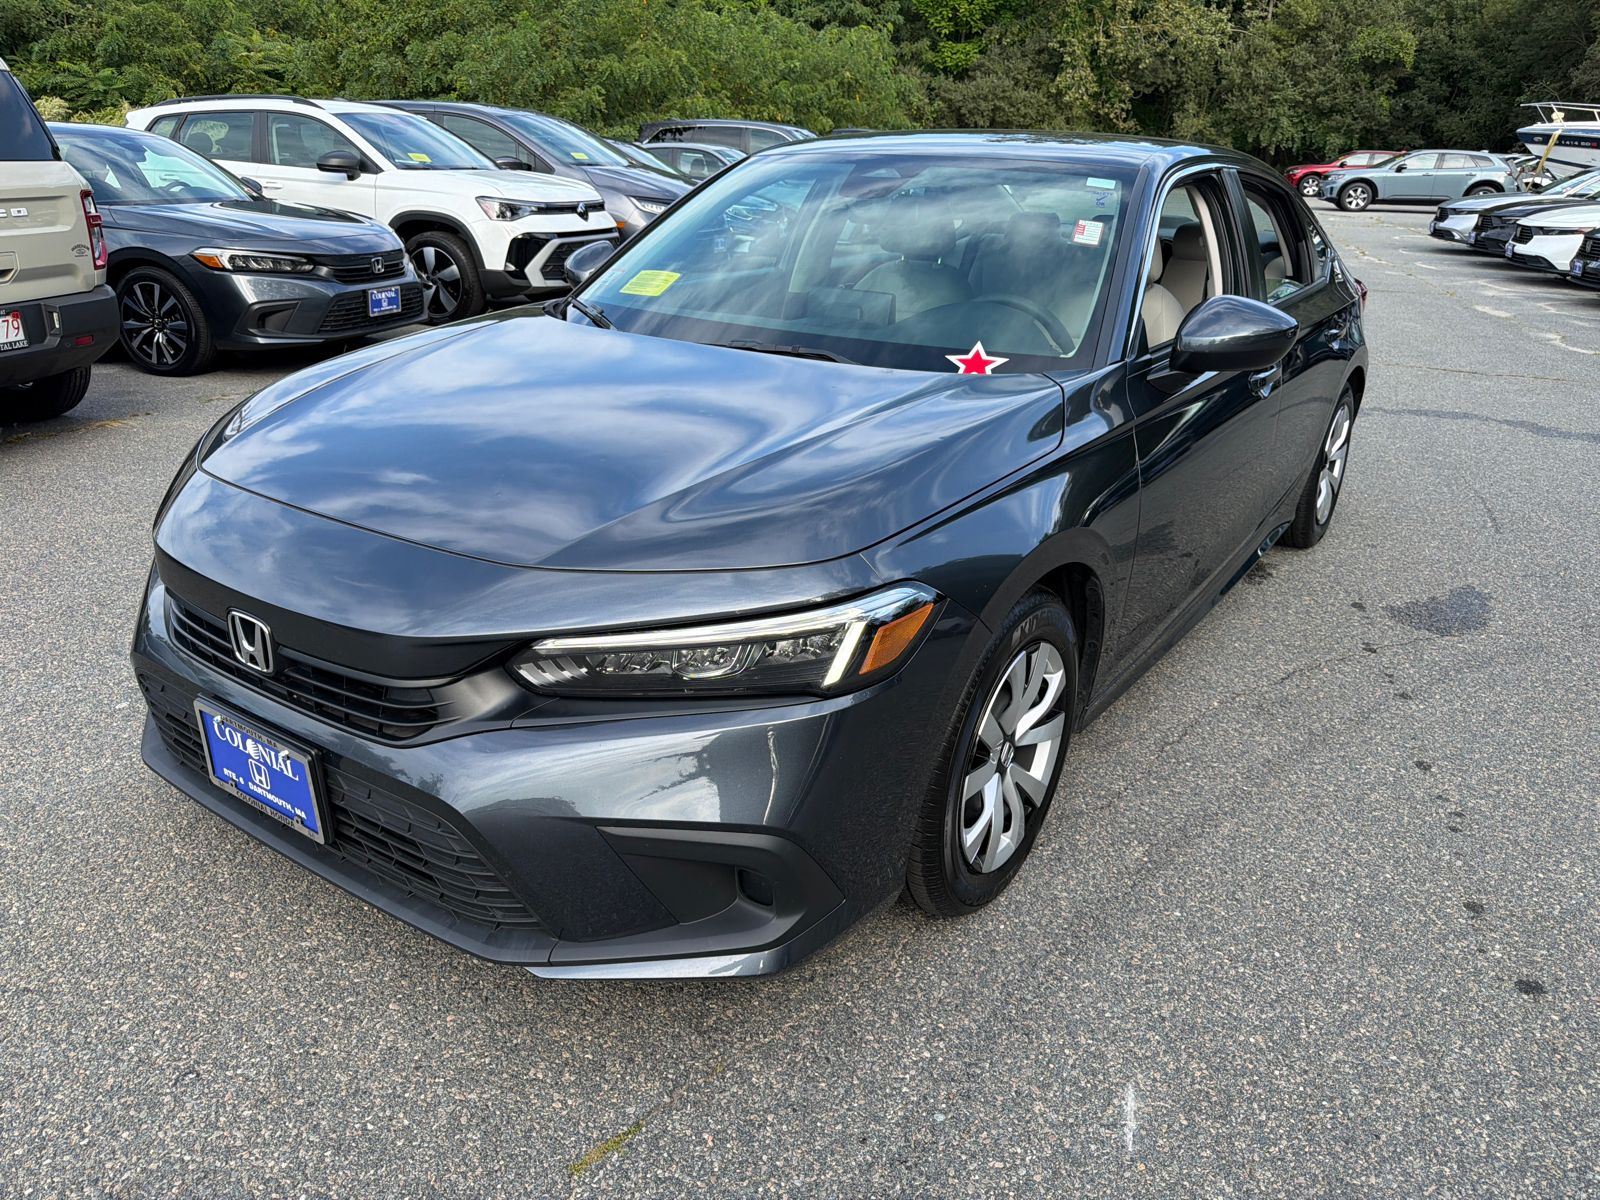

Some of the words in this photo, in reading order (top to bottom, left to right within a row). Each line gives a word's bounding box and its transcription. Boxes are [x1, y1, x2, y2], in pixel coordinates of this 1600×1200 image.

[12, 340, 29, 349] LAKE
[212, 718, 300, 781] COLONIAL
[266, 738, 279, 749] MA
[223, 766, 239, 782] RTE.
[248, 781, 295, 814] DARTMOUTH,
[294, 806, 307, 820] MA
[236, 790, 269, 814] COLONIAL
[270, 809, 296, 829] HONDA
